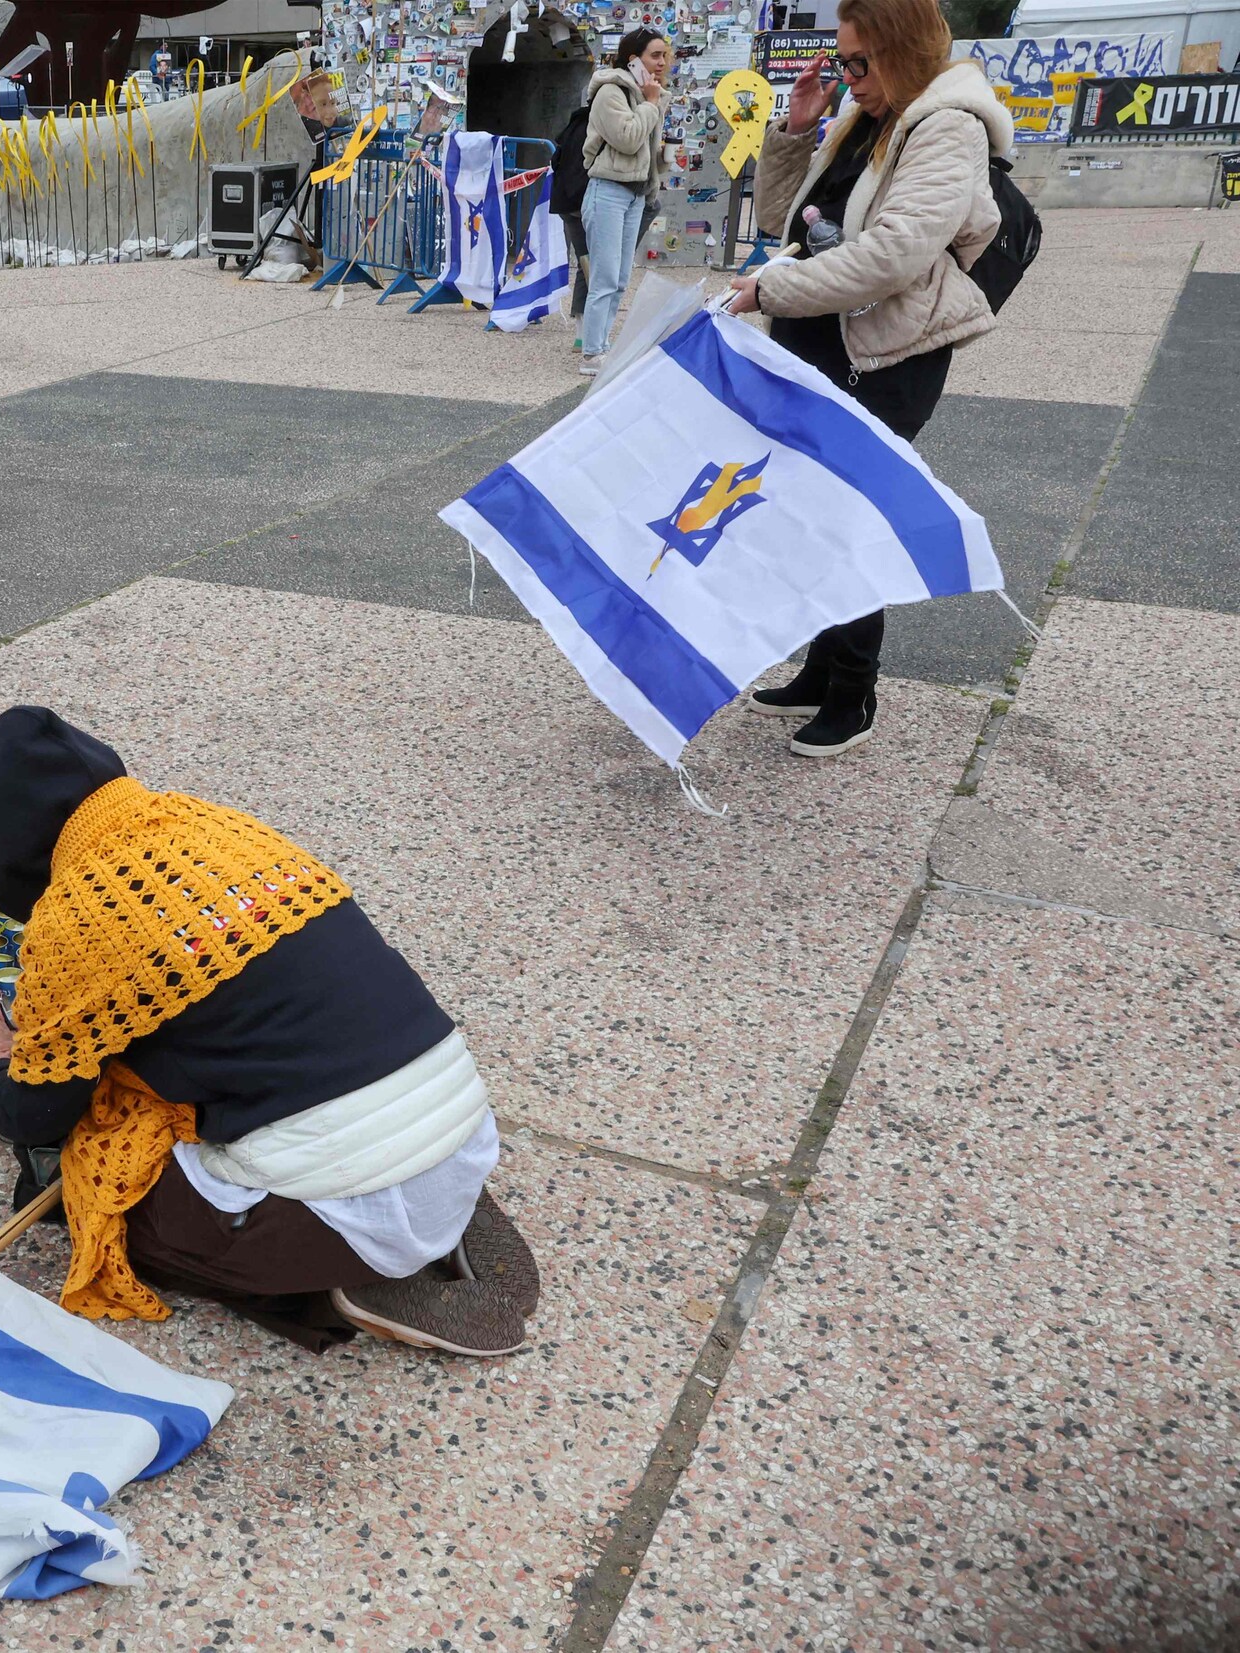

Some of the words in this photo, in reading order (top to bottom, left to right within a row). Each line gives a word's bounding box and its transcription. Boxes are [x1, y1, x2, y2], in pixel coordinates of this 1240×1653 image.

[770, 38, 790, 49] (86)
[793, 39, 820, 48] מנצור
[770, 50, 796, 58] חמאס
